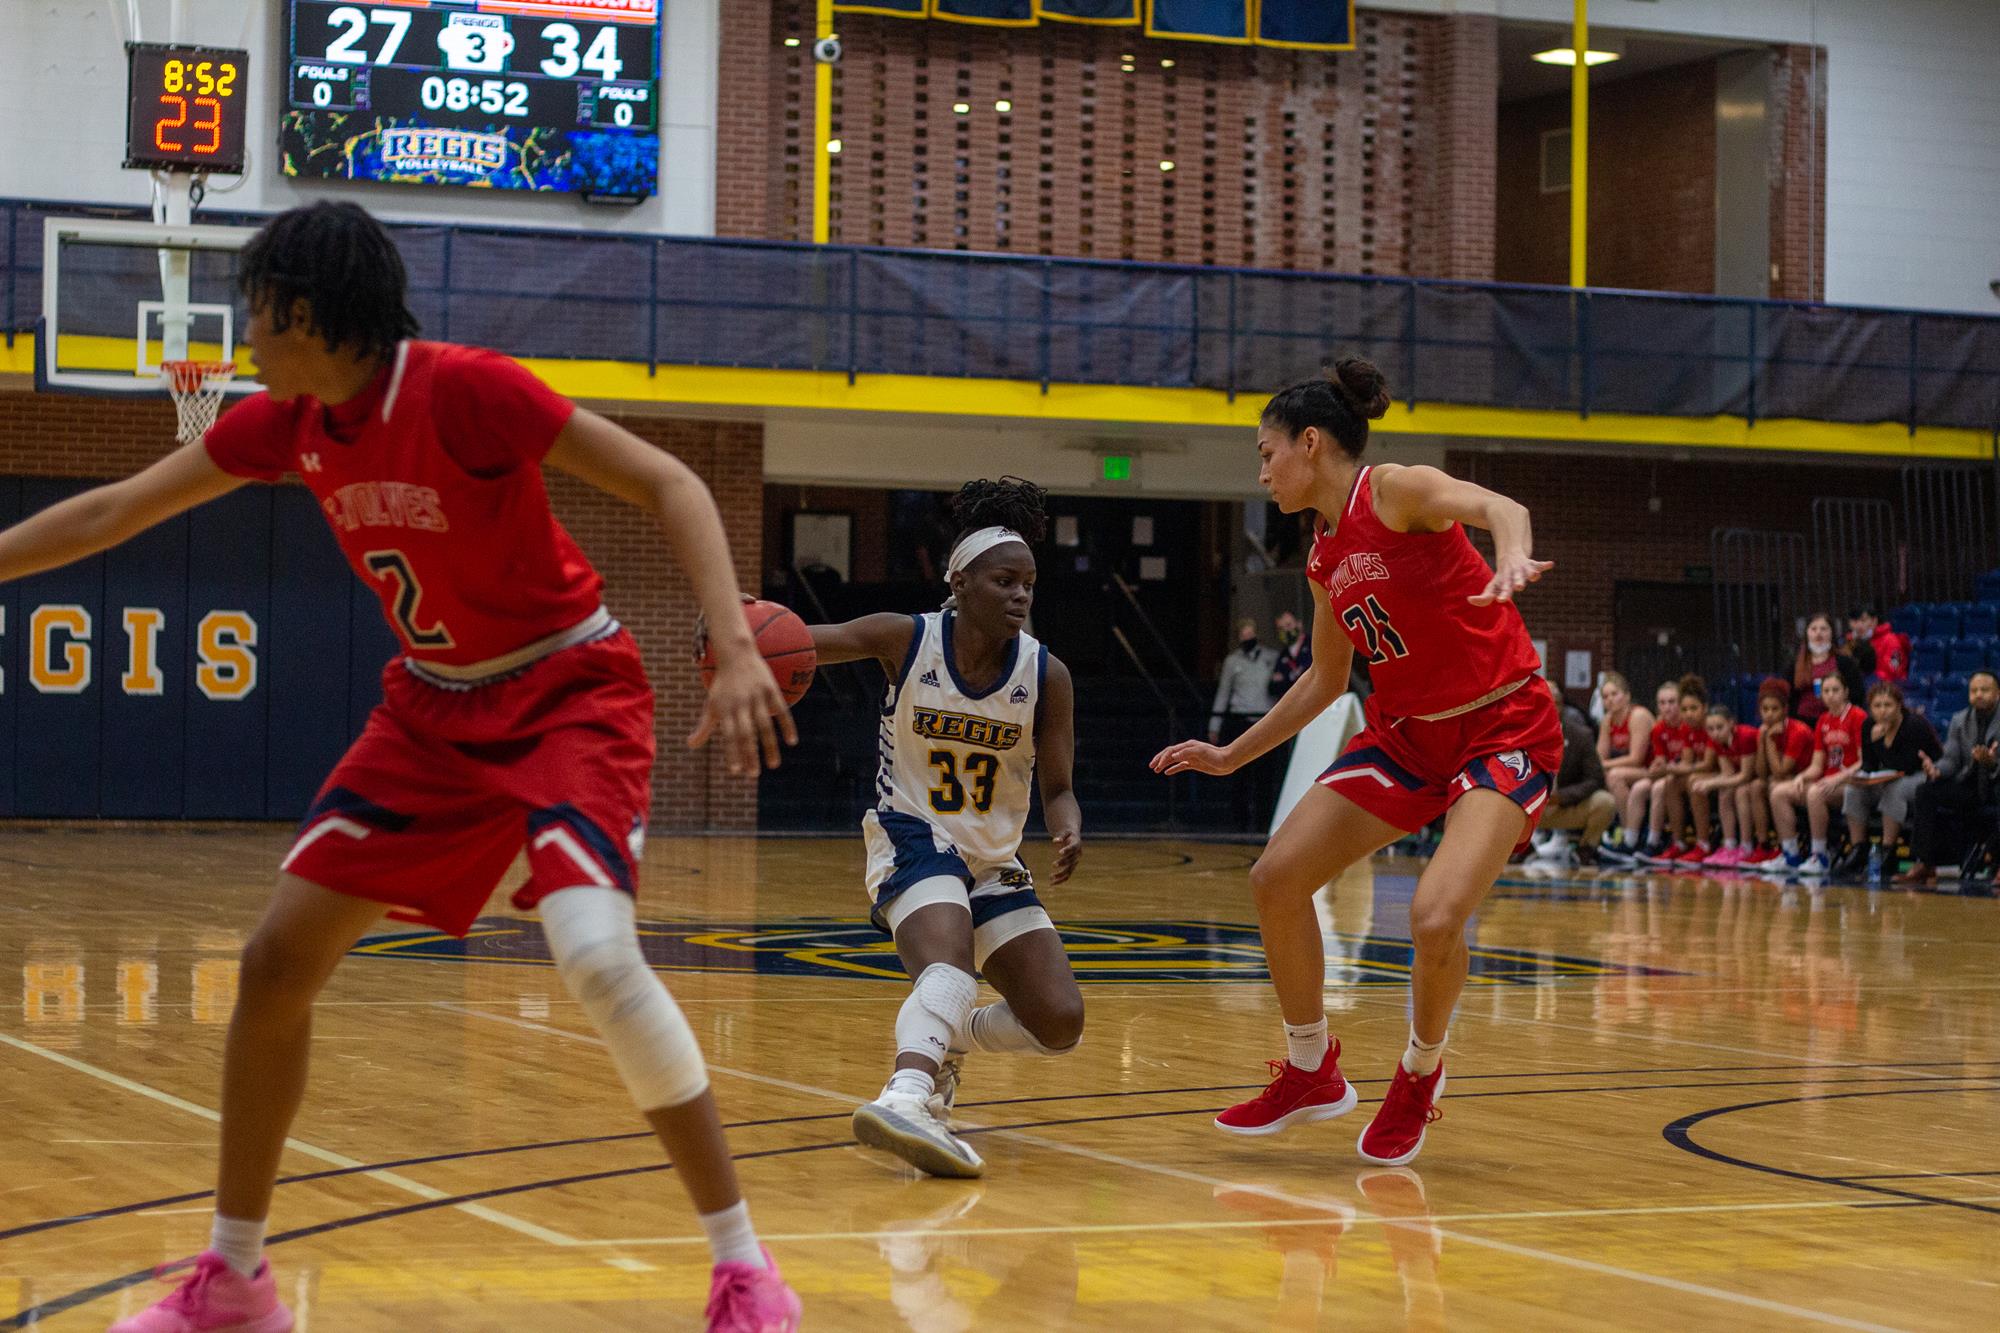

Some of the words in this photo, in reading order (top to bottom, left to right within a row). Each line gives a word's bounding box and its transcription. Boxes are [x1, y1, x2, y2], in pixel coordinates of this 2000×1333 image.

[326, 7, 412, 65] 27
[466, 32, 486, 63] 3
[540, 23, 622, 81] 34
[164, 60, 236, 96] 8:52
[298, 65, 348, 81] FOULS
[313, 81, 332, 107] 0
[421, 76, 529, 116] 08:52
[599, 86, 648, 101] FOULS
[155, 95, 221, 153] 23
[614, 102, 633, 127] 0
[386, 131, 503, 164] REGIS
[395, 158, 486, 175] VOLLEYBALL
[363, 549, 456, 649] 2
[0, 604, 257, 700] GIS
[913, 707, 1022, 749] REGIS
[928, 749, 999, 815] 33
